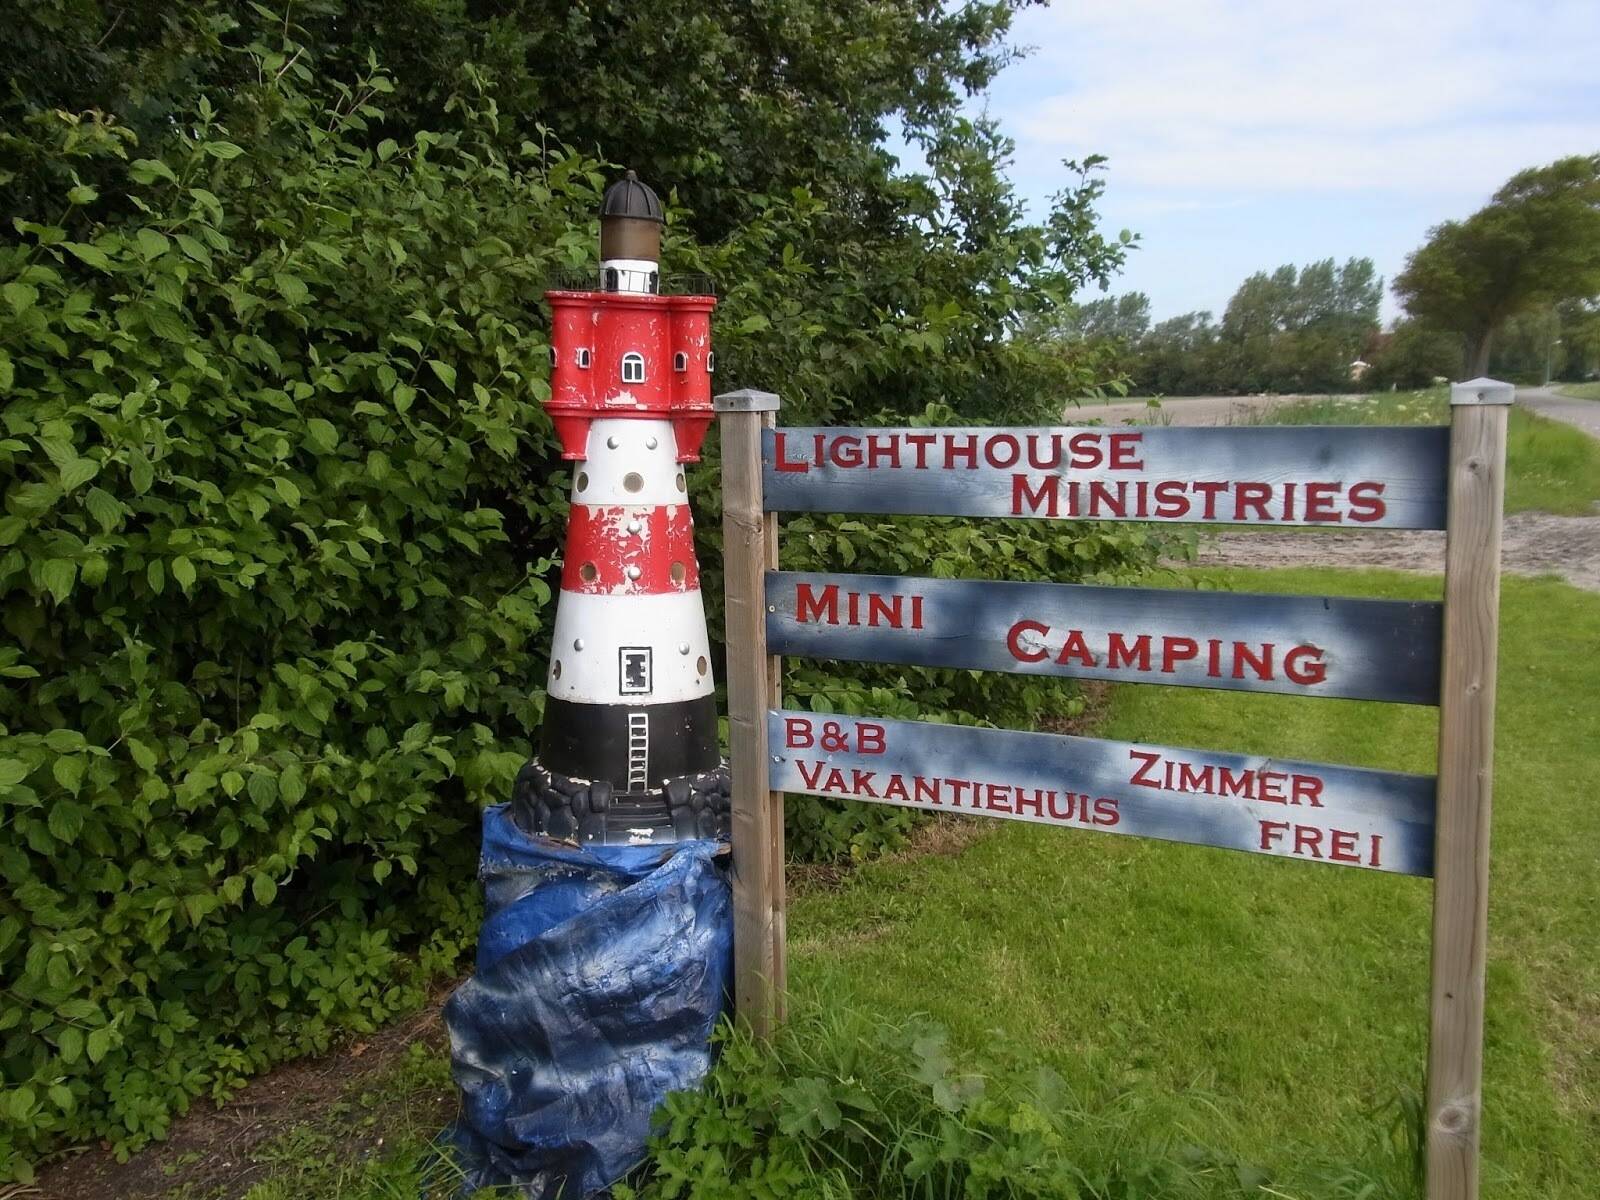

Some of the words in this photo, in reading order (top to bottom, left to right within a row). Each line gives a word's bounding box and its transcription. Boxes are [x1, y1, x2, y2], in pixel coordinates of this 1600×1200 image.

[774, 431, 1145, 473] LIGHTHOUSE
[1011, 473, 1387, 522] MINISTRIES
[794, 582, 925, 631] MINI
[1006, 619, 1328, 686] CAMPING
[785, 717, 888, 755] B&B
[795, 759, 1121, 827] VAKANTIEHUIS
[1129, 749, 1325, 808] ZIMMER
[1259, 819, 1383, 868] FREI
